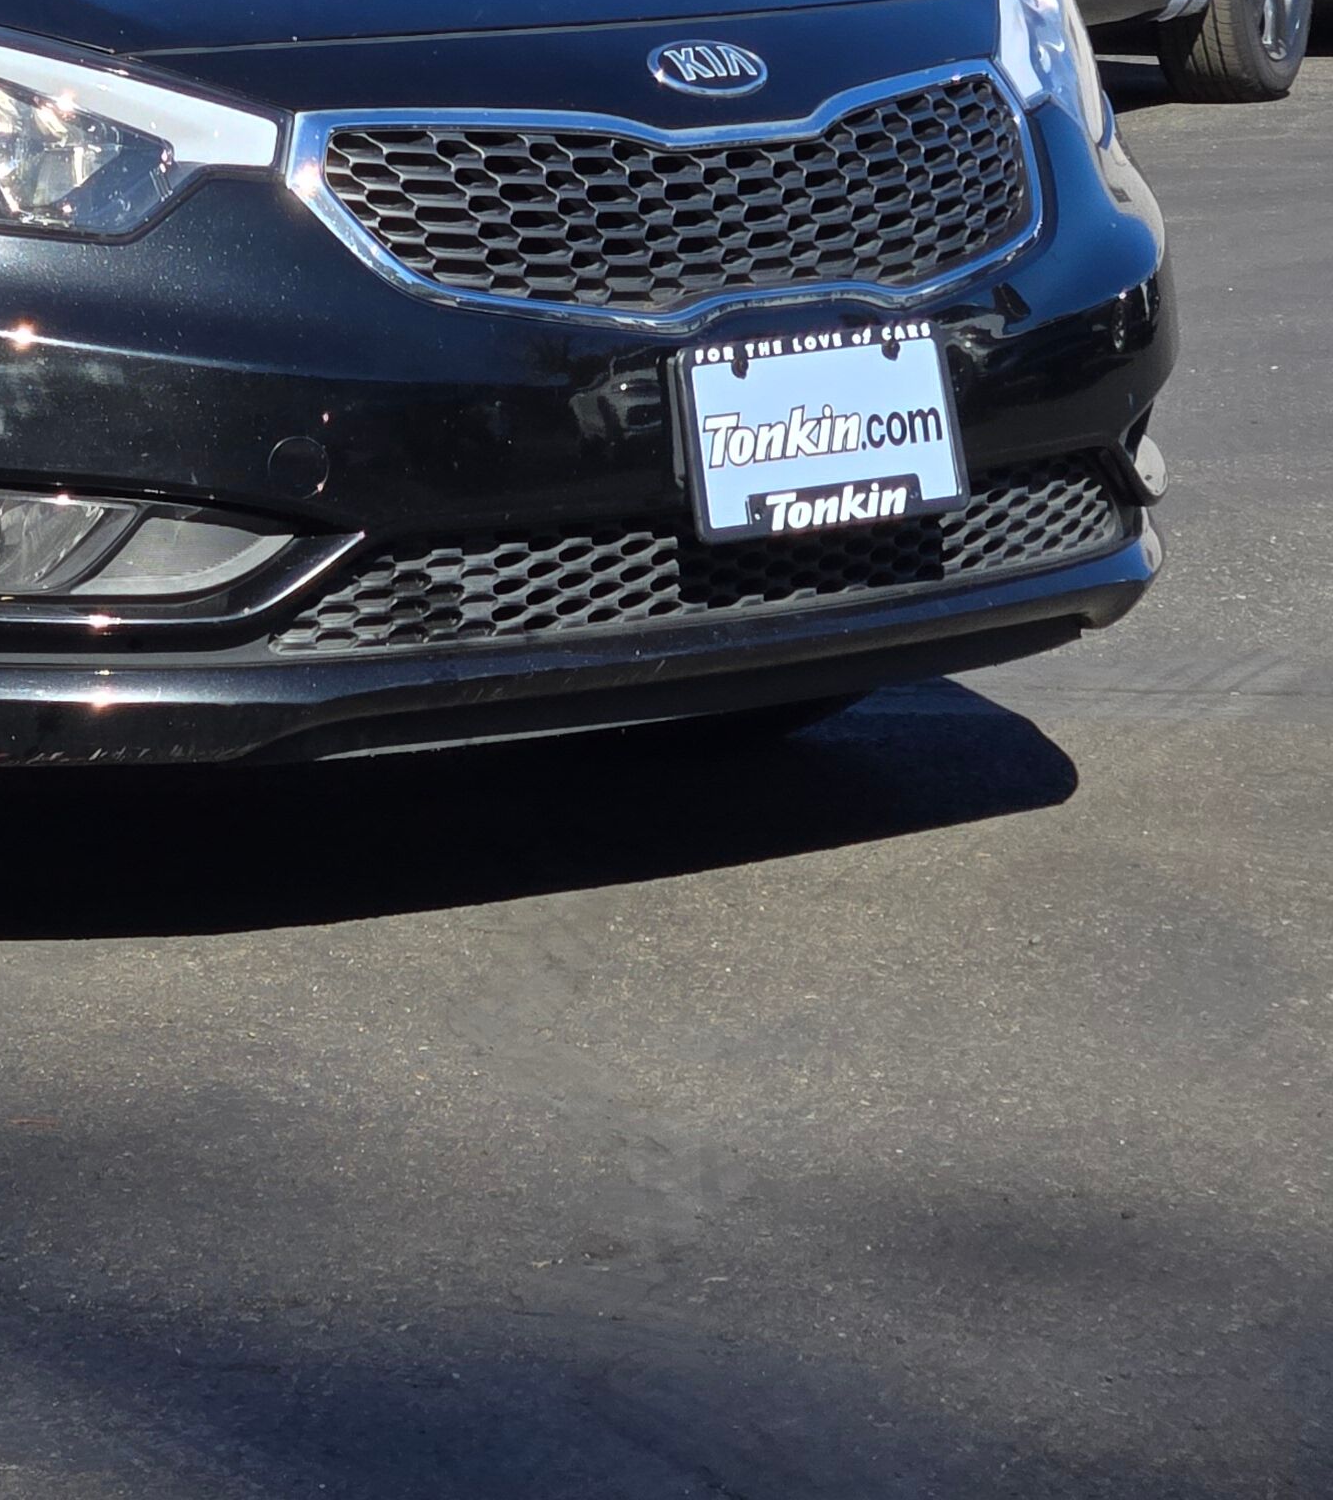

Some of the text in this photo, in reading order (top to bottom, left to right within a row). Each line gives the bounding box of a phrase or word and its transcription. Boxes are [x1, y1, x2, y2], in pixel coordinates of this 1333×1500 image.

[663, 45, 758, 81] KIA
[694, 345, 734, 364] FOR
[744, 339, 783, 358] THE
[792, 332, 843, 352] LOVE
[881, 322, 931, 340] CARS
[702, 403, 944, 469] Tonkin.com
[765, 481, 908, 532] Tonkin
